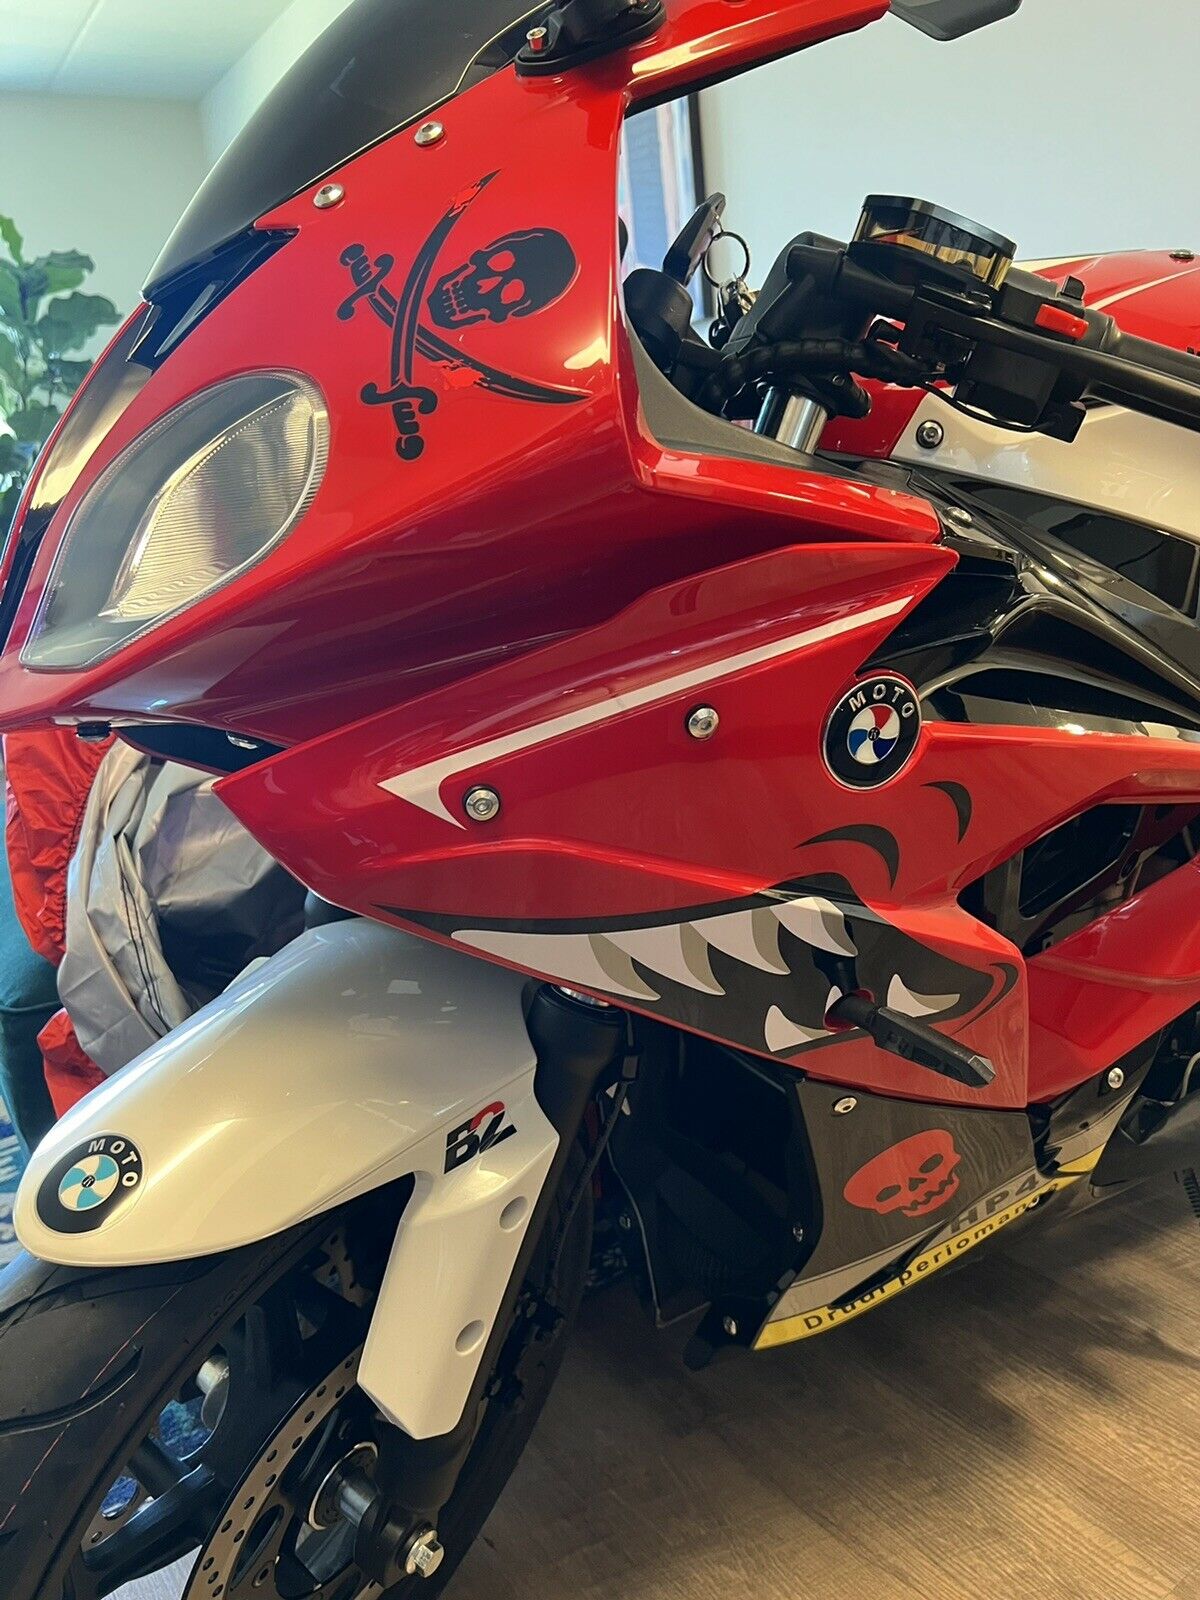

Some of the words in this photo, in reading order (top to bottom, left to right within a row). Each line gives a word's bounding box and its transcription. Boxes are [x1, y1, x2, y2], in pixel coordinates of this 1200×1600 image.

[848, 683, 915, 718] MOTO
[88, 1138, 139, 1187] MOTO
[950, 1173, 1039, 1234] HP4
